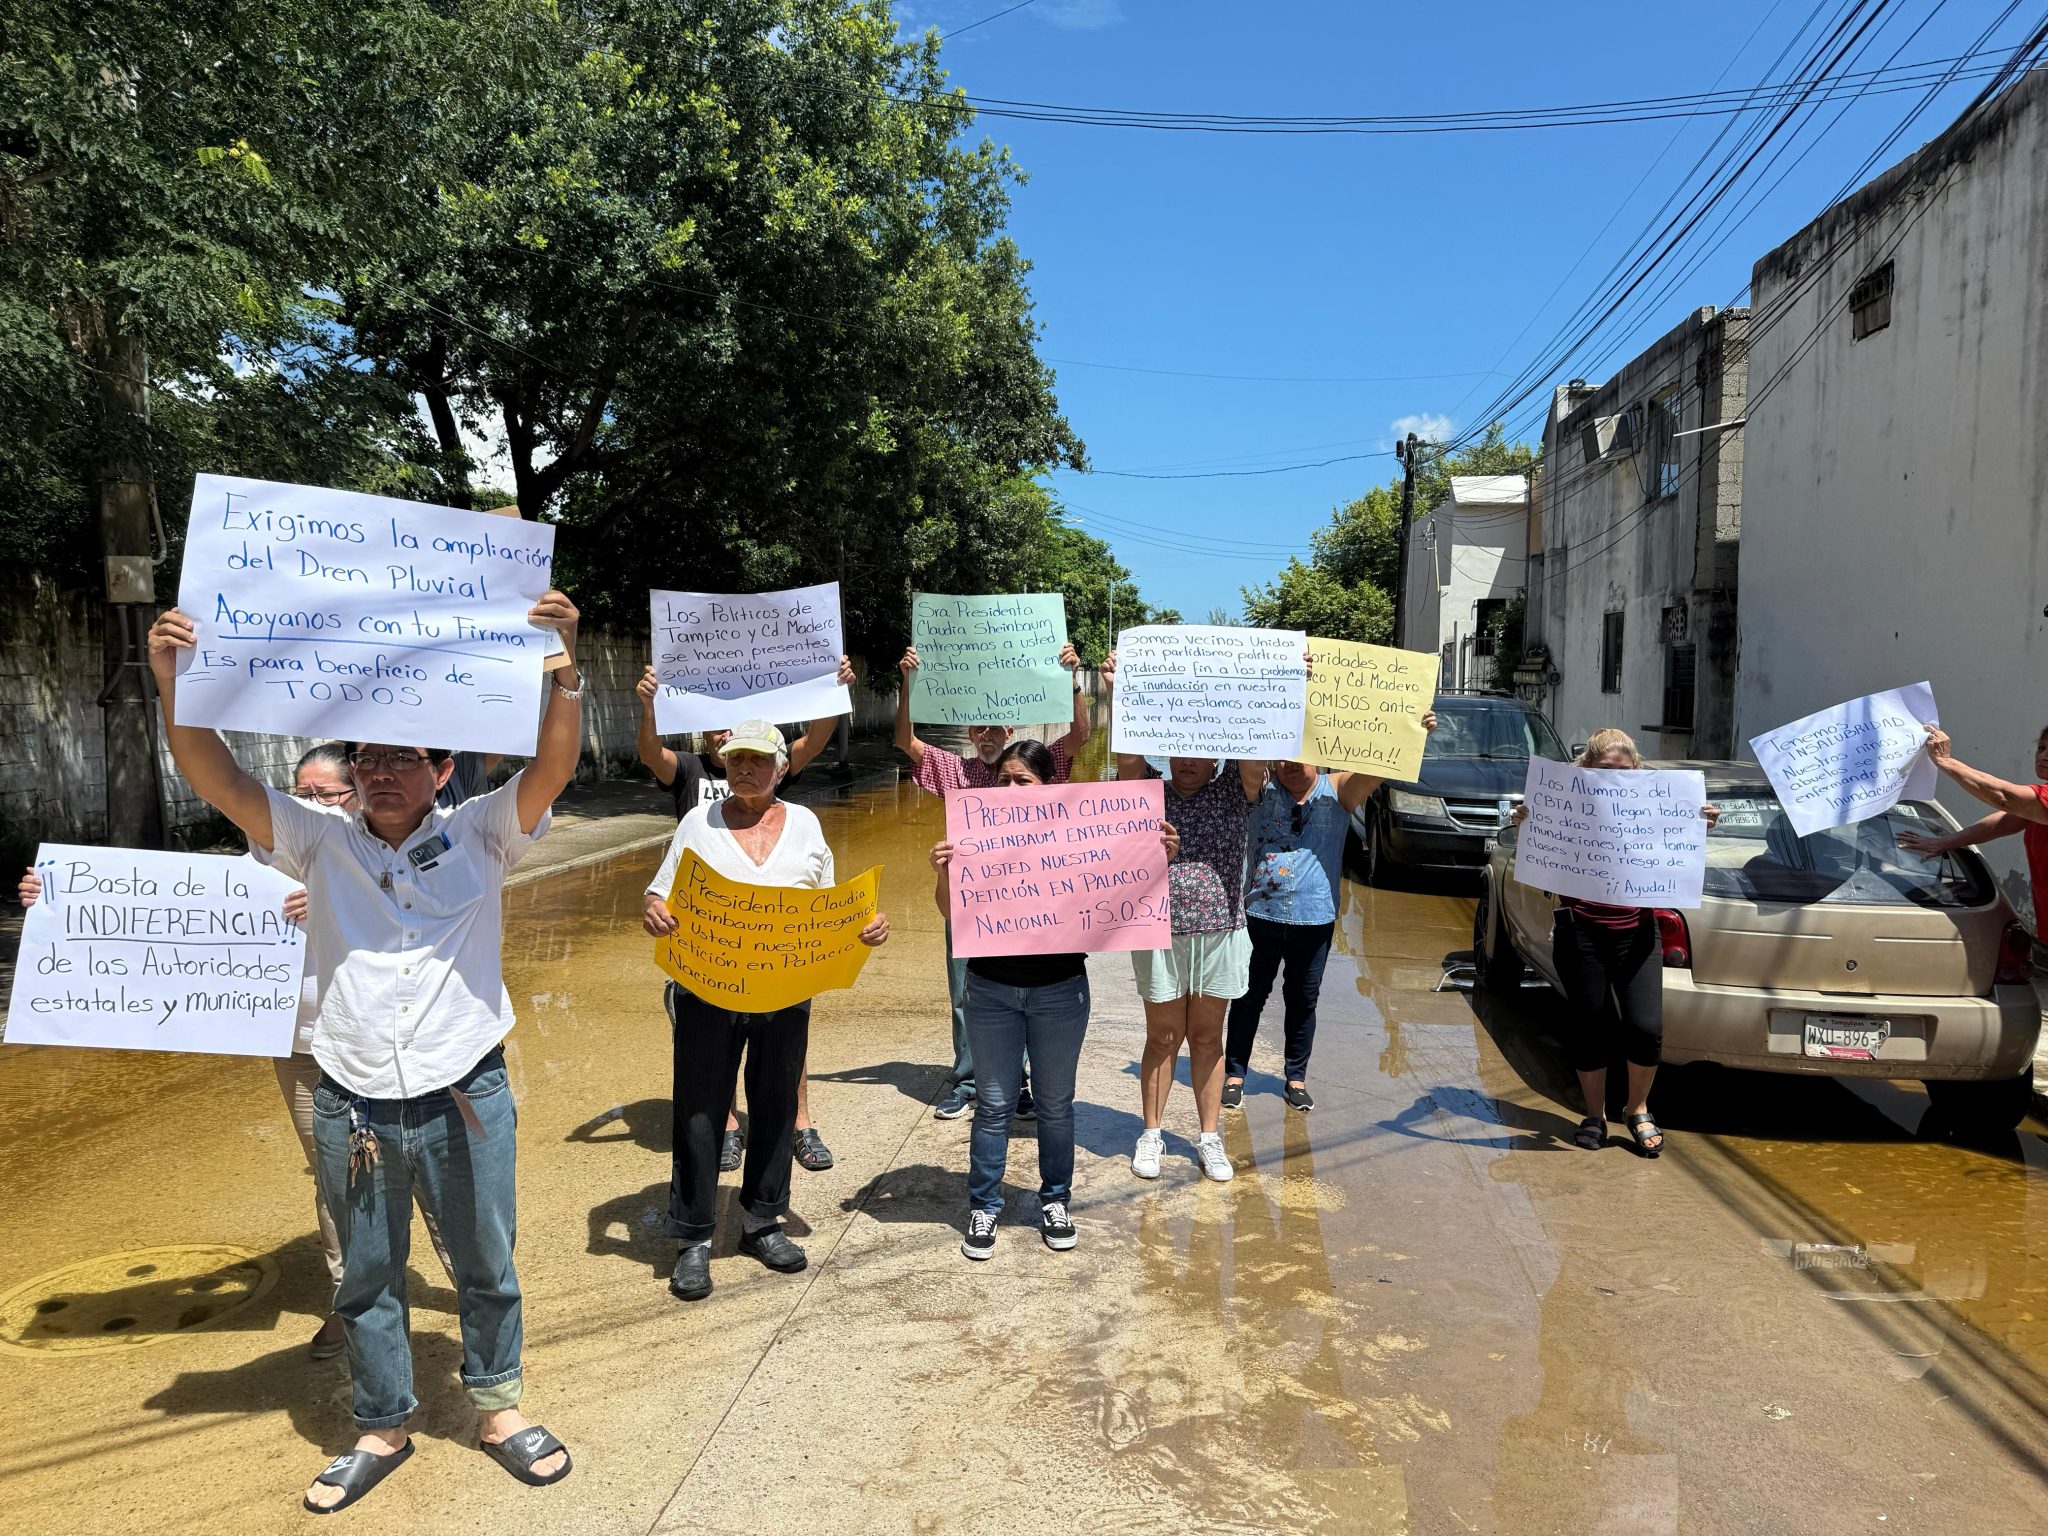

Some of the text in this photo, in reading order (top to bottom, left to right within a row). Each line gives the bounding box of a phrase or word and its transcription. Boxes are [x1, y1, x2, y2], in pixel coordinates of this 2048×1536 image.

[222, 492, 552, 568] Exigimos la ampliación
[228, 541, 488, 600] del Dren Pluvial
[214, 593, 525, 648] Apoyanos con tu Firma
[668, 601, 700, 624] Los
[789, 601, 812, 617] de
[919, 599, 1033, 617] Sra. Presidenta
[659, 617, 835, 646] Tampico y Cd. Madero
[917, 619, 1052, 636] Claudia Sheinbaum
[1124, 630, 1179, 646] Somos
[1250, 636, 1295, 648] Unidos
[661, 638, 829, 664] se hacen presentes
[916, 632, 1055, 656] entregamos a usted
[1163, 647, 1232, 662] partidismo
[202, 650, 474, 686] Es para beneficio de
[662, 653, 836, 680] solo cuando necesitan
[978, 653, 1036, 676] petición
[1045, 655, 1059, 664] en
[1124, 663, 1185, 679] pidiendo
[1193, 661, 1212, 676] fin
[1234, 662, 1255, 676] los
[1388, 657, 1408, 674] de
[265, 680, 422, 707] TODOS
[665, 672, 793, 698] nuestro VOTO.
[917, 678, 976, 696] Palacio
[1122, 679, 1286, 692] de inundación en nuestra
[1335, 676, 1340, 691] y
[1347, 672, 1365, 687] Cd.
[1370, 674, 1419, 692] Madero
[983, 686, 1046, 709] Nacional
[1167, 697, 1183, 711] ya
[1188, 697, 1242, 709] estamos
[1248, 699, 1301, 710] cansados
[1310, 691, 1416, 714] OMISOS ante
[941, 707, 1020, 723] ¡Ayudenos!
[1122, 713, 1137, 722] de
[1169, 711, 1221, 723] nuestras
[1229, 716, 1266, 724] casas
[1124, 728, 1295, 741] inundadas y nuestras familias
[1159, 739, 1258, 754] enfermandose
[1763, 722, 1849, 753] Tenemos
[1789, 717, 1905, 760] INSALUBRIDAD
[1316, 736, 1400, 764] ¡¡Ayuda!!
[1783, 752, 1847, 780] Nuestros
[1790, 766, 1847, 791] abuelos
[1854, 758, 1872, 768] se
[1878, 752, 1902, 762] nos
[1540, 768, 1670, 798] Los Alumnos del
[1795, 770, 1878, 804] enfermando
[1079, 796, 1150, 816] CLAUDIA
[1533, 793, 1695, 820] CBTA 12 llegan todos
[1531, 807, 1686, 839] los días mojados por
[959, 818, 1163, 856] SHEINBAUM ENTREGAMOS
[1529, 821, 1699, 854] inundaciones, para tomar
[1527, 837, 1685, 868] clases y con riesgo de
[960, 849, 1111, 884] A USTED NUESTRA
[1525, 854, 1615, 880] enfermarse.
[173, 867, 205, 897] de
[224, 869, 248, 898] la
[689, 861, 866, 914] Presidenta Claudia
[960, 869, 1149, 908] PETICIÓN EN PALACIO
[675, 890, 774, 933] Sheinbaum
[784, 902, 874, 933] entregamos
[976, 912, 1064, 938] NACIONAL
[691, 922, 742, 949] Usted
[754, 940, 822, 952] nuestra
[38, 942, 290, 982] de las Autoridades
[747, 962, 773, 970] en
[782, 944, 855, 969] Palacio
[669, 948, 751, 994] Nacional.
[31, 986, 296, 1030] estatales y municipales
